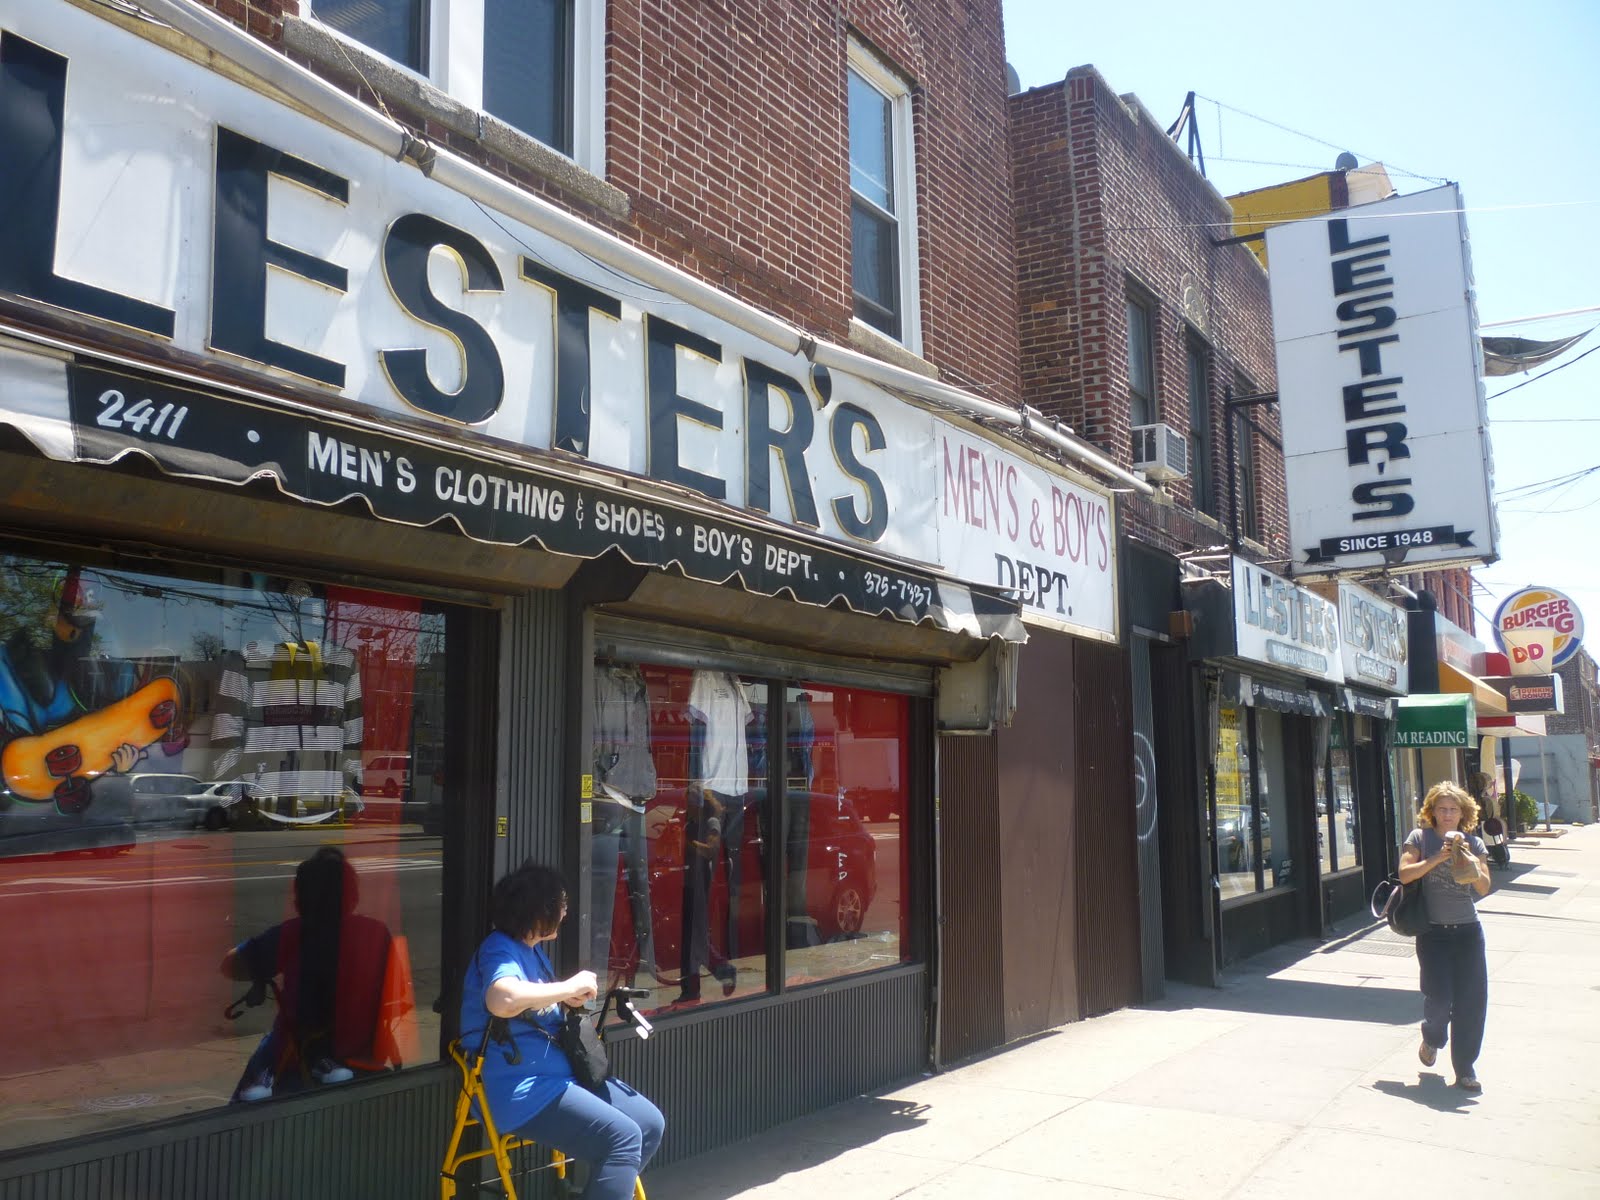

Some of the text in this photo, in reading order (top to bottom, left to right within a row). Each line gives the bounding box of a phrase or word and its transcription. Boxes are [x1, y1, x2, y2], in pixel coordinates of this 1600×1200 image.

[0, 28, 889, 542] LESTER'S
[1327, 217, 1415, 522] LESTER'S
[97, 390, 188, 439] 2411
[308, 430, 416, 493] MEN'S
[435, 466, 565, 522] CLOTHING
[595, 501, 665, 541] SHOES
[693, 524, 753, 565] BOY'S
[765, 544, 819, 581] DEPT.
[943, 436, 1108, 572] MEN'S & BOY'S
[1340, 530, 1433, 552] SINCE 1948
[994, 552, 1073, 617] DEPT.
[1503, 599, 1570, 631] BURGER
[1512, 643, 1544, 664] DD
[1411, 731, 1466, 744] READING
